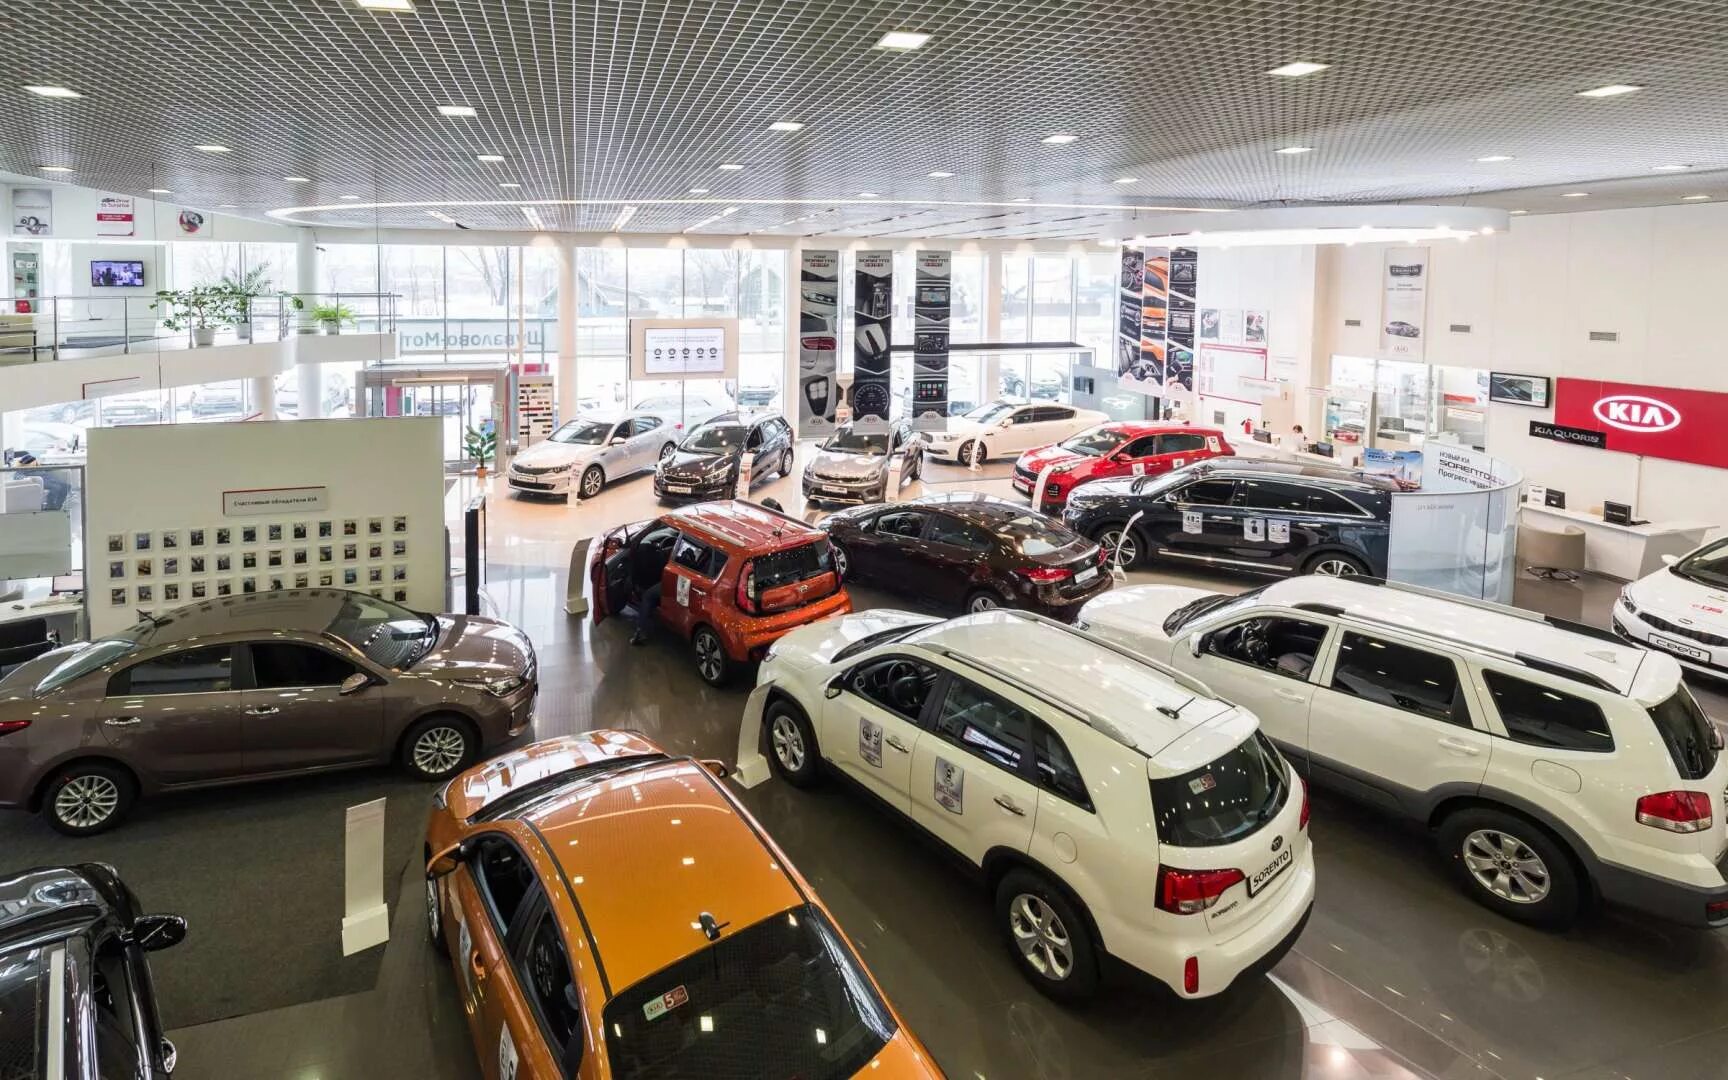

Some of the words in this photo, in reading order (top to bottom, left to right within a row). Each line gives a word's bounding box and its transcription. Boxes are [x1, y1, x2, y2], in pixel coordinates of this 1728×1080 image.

[1608, 402, 1665, 426] KIA
[1534, 426, 1553, 436] KIA
[1438, 468, 1468, 483] Прогресс
[1253, 850, 1289, 888] SORENTO
[665, 994, 675, 1008] 5
